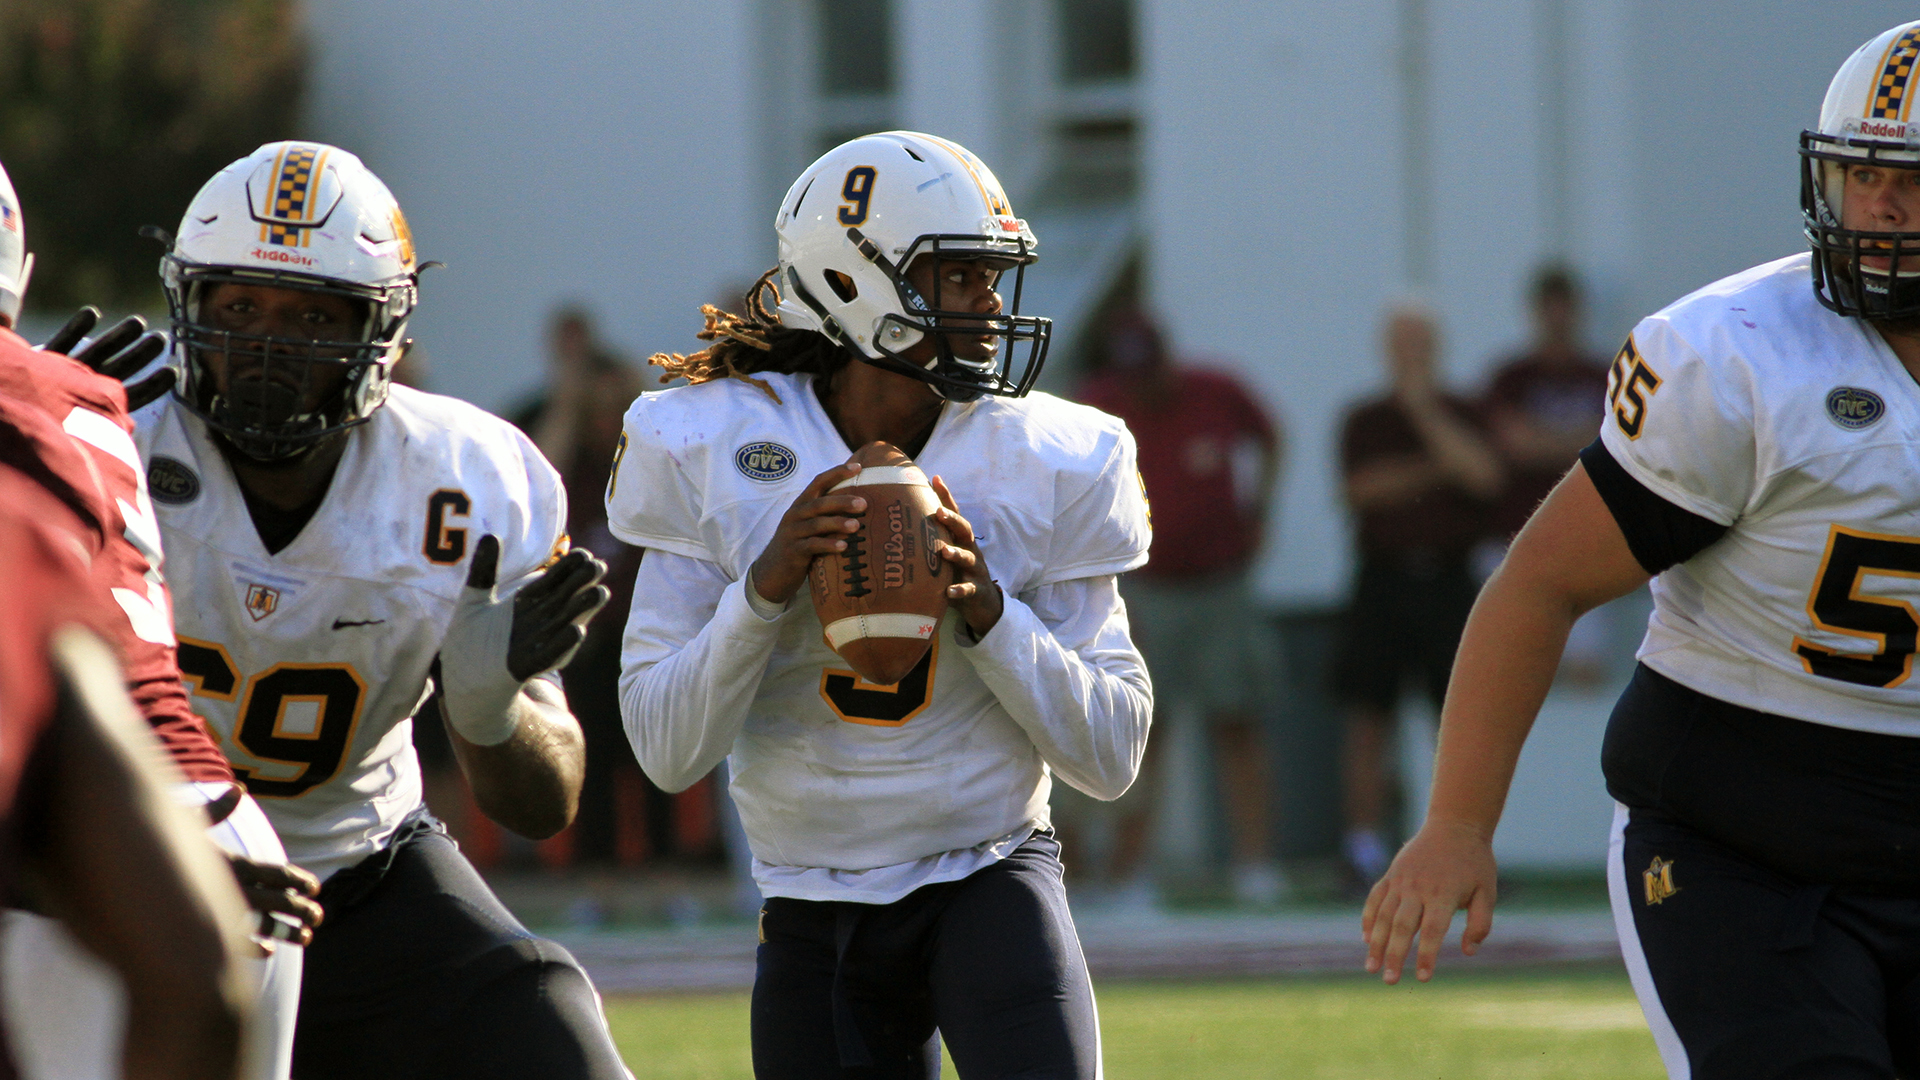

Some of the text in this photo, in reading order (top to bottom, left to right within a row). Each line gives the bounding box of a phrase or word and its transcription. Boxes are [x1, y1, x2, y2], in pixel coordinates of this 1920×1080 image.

[1860, 122, 1905, 138] Riddell
[836, 165, 878, 228] 9
[1607, 331, 1663, 441] 55
[748, 453, 783, 470] OVC
[422, 488, 473, 567] G
[884, 501, 905, 590] Wilson
[1790, 523, 1920, 689] 5
